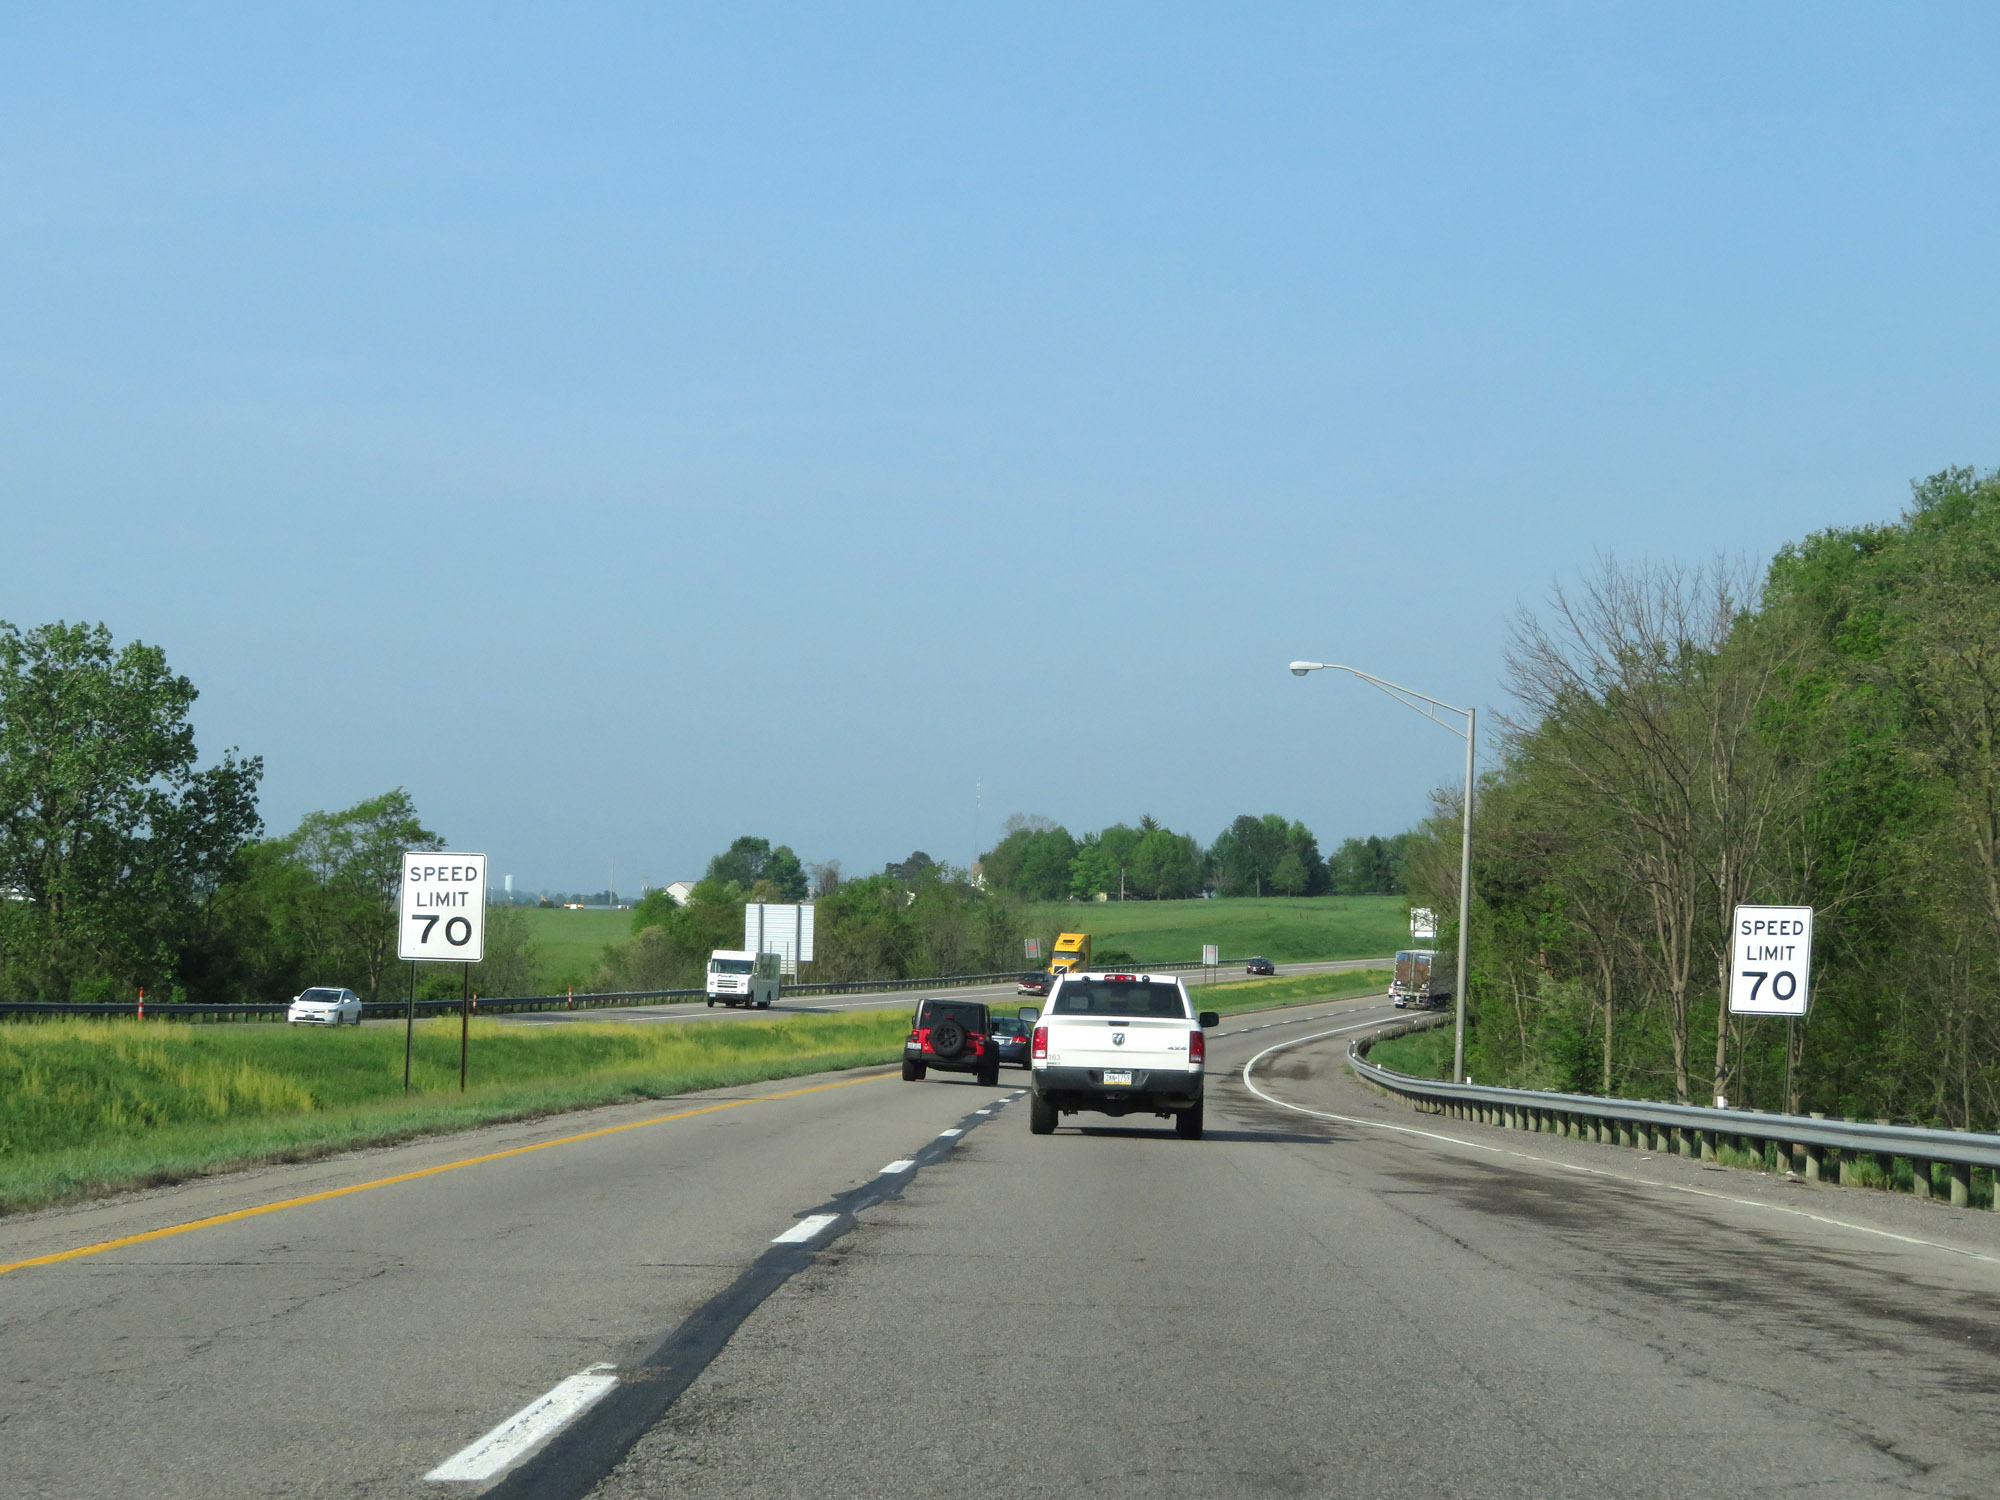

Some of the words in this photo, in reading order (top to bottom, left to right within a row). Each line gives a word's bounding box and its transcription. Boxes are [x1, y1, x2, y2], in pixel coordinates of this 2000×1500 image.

[410, 866, 477, 882] SPEED
[417, 892, 469, 907] LIMIT
[411, 914, 472, 946] 70
[1741, 920, 1804, 935] SPEED
[1747, 945, 1795, 961] LIMIT
[1742, 971, 1797, 1001] 70
